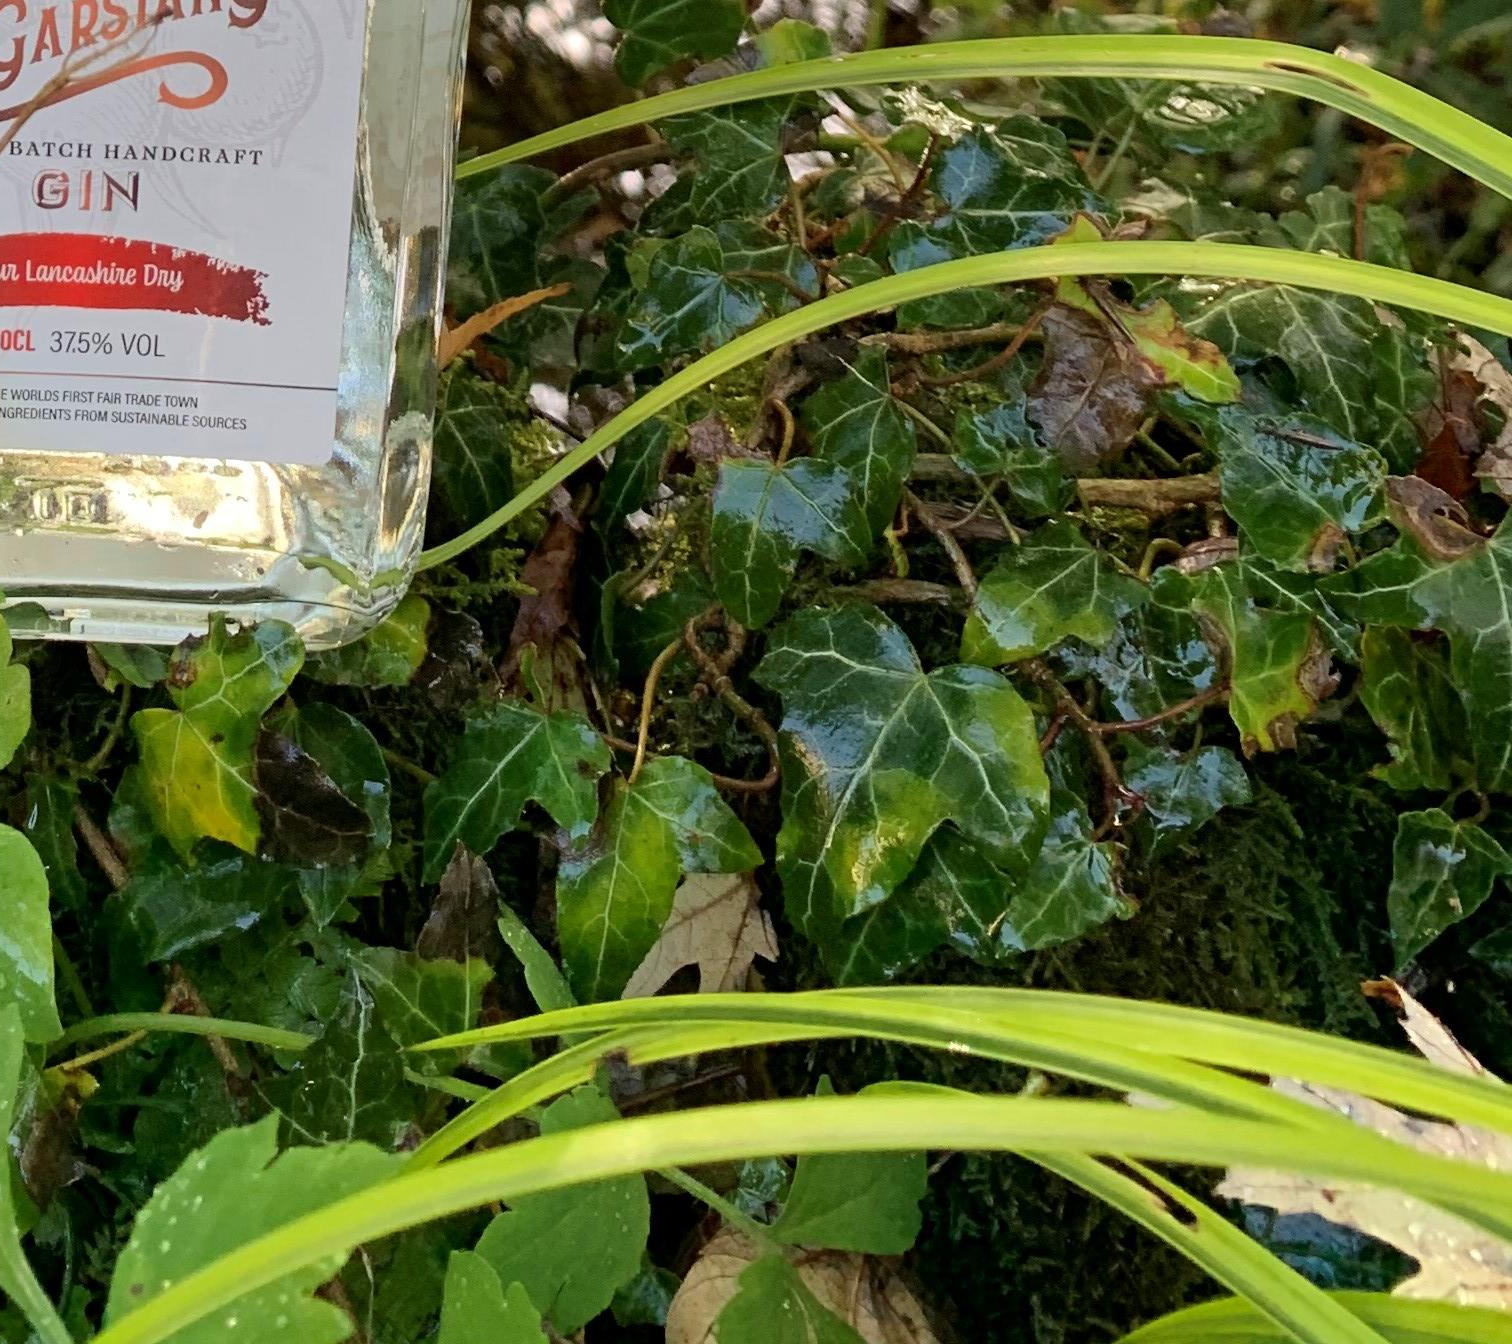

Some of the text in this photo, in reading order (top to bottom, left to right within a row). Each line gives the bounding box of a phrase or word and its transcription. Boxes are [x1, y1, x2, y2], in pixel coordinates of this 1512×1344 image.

[9, 140, 93, 158] BATCH
[104, 144, 263, 165] HANDCRAFT
[32, 169, 140, 211] GIN
[25, 259, 136, 285] Lancashire
[143, 264, 184, 292] Dry
[50, 330, 113, 355] 37.5%
[121, 333, 166, 357] VOL
[10, 389, 59, 402] WORLDS
[62, 390, 95, 404] FIRST
[97, 392, 122, 405] FAIR
[125, 393, 161, 407] TRADE
[164, 395, 198, 409] TOWN
[74, 409, 108, 423] FROM
[111, 411, 189, 427] SUSTAINABLE
[192, 415, 247, 431] SOURCES
